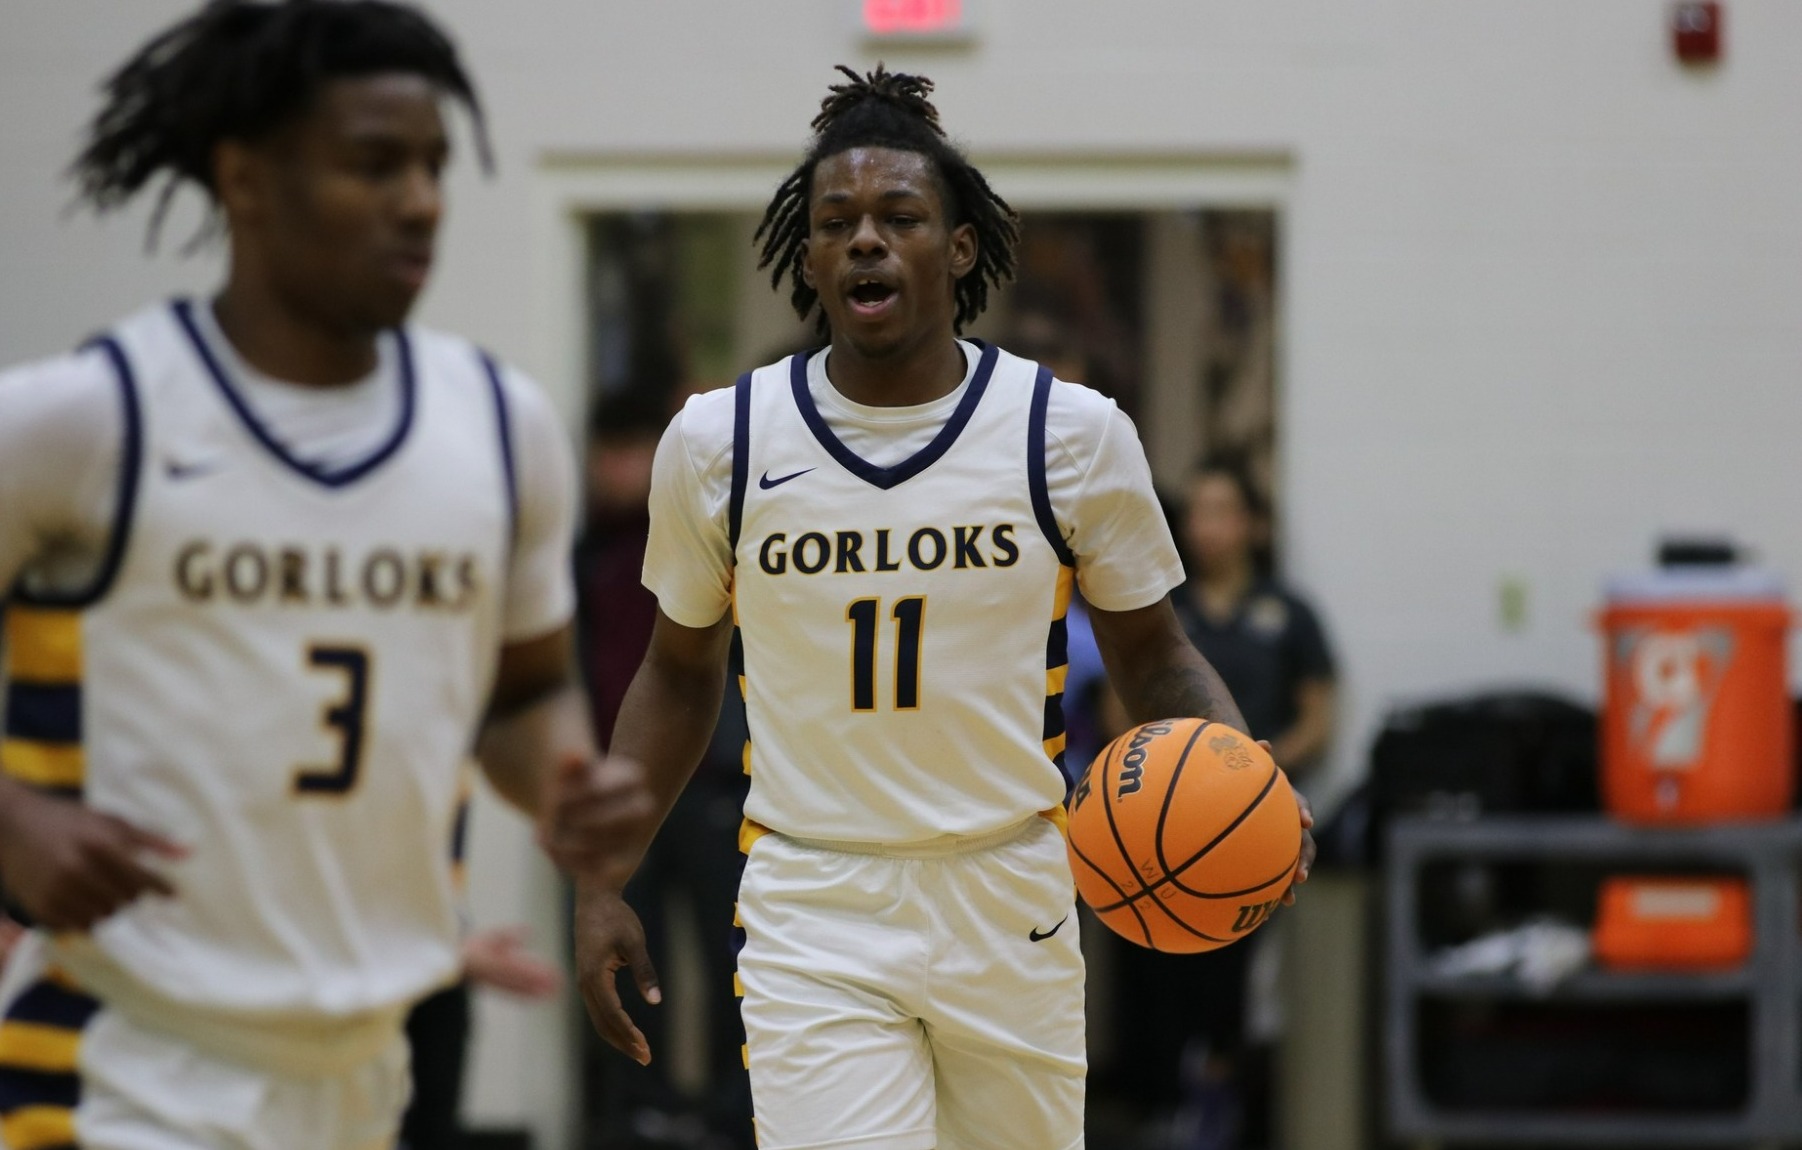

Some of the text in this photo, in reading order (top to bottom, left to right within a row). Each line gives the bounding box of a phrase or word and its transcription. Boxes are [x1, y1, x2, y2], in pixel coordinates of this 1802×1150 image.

[174, 540, 480, 612] GORLOKS
[758, 523, 1020, 576] GORLOKS
[844, 594, 928, 713] 11
[291, 642, 374, 799] 3
